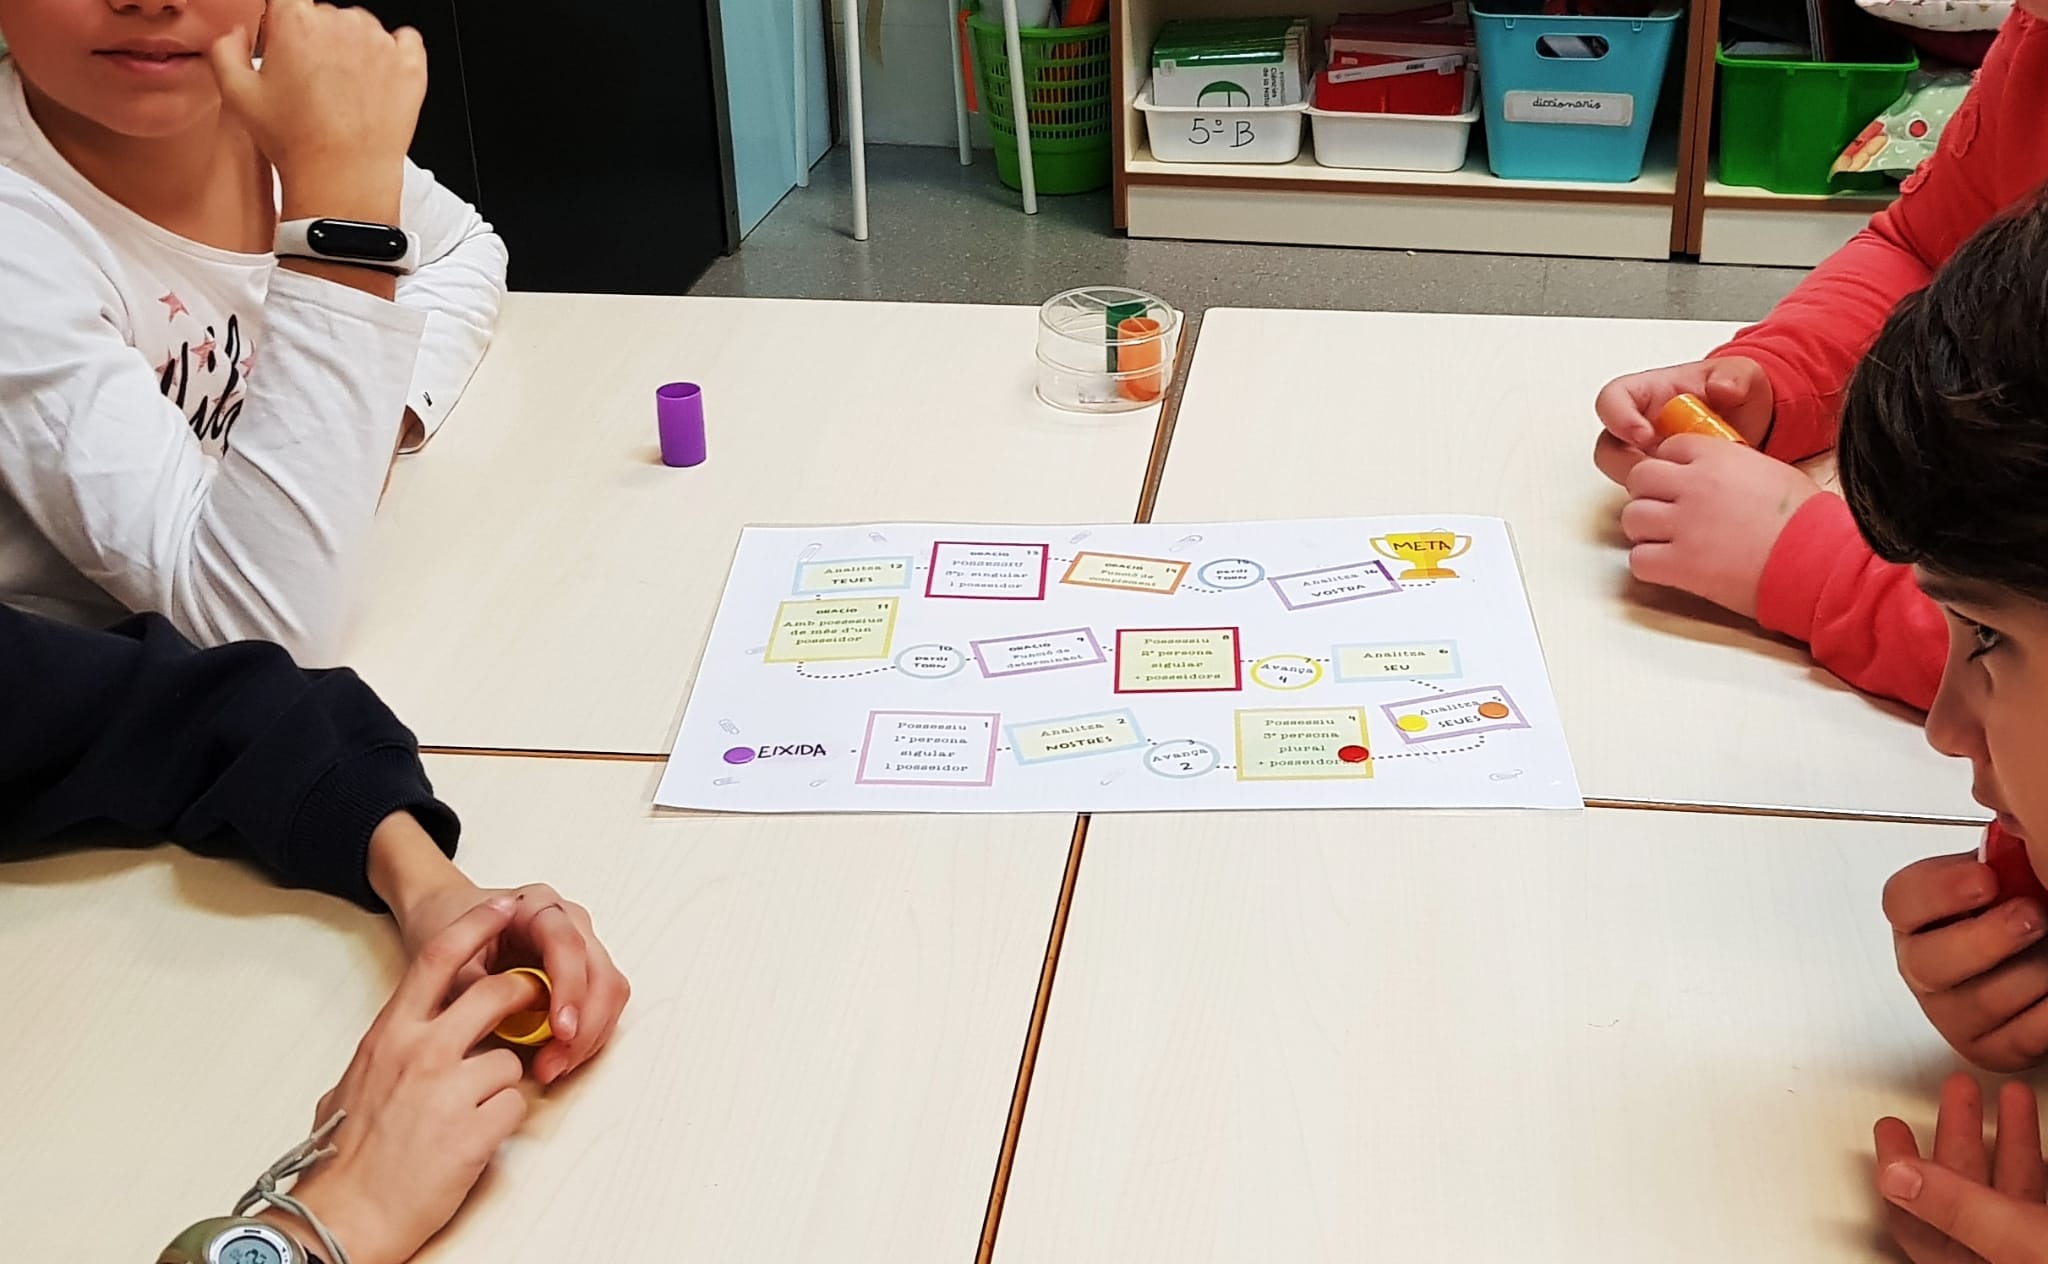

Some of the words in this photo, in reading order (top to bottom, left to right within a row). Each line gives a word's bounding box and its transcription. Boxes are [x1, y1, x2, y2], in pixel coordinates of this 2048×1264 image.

[1229, 119, 1256, 148] B
[1392, 539, 1452, 551] META
[1310, 583, 1367, 598] VOSTRA
[1383, 663, 1411, 672] SEU
[1116, 717, 1127, 725] 2
[1437, 714, 1482, 729] SEUES
[908, 735, 969, 745] persona
[1280, 732, 1341, 741] persona
[1045, 735, 1114, 752] NOSTRES
[1279, 744, 1326, 754] plural
[757, 743, 827, 759] EIXIDA
[1151, 747, 1209, 763] Avança
[1179, 761, 1194, 771] 2
